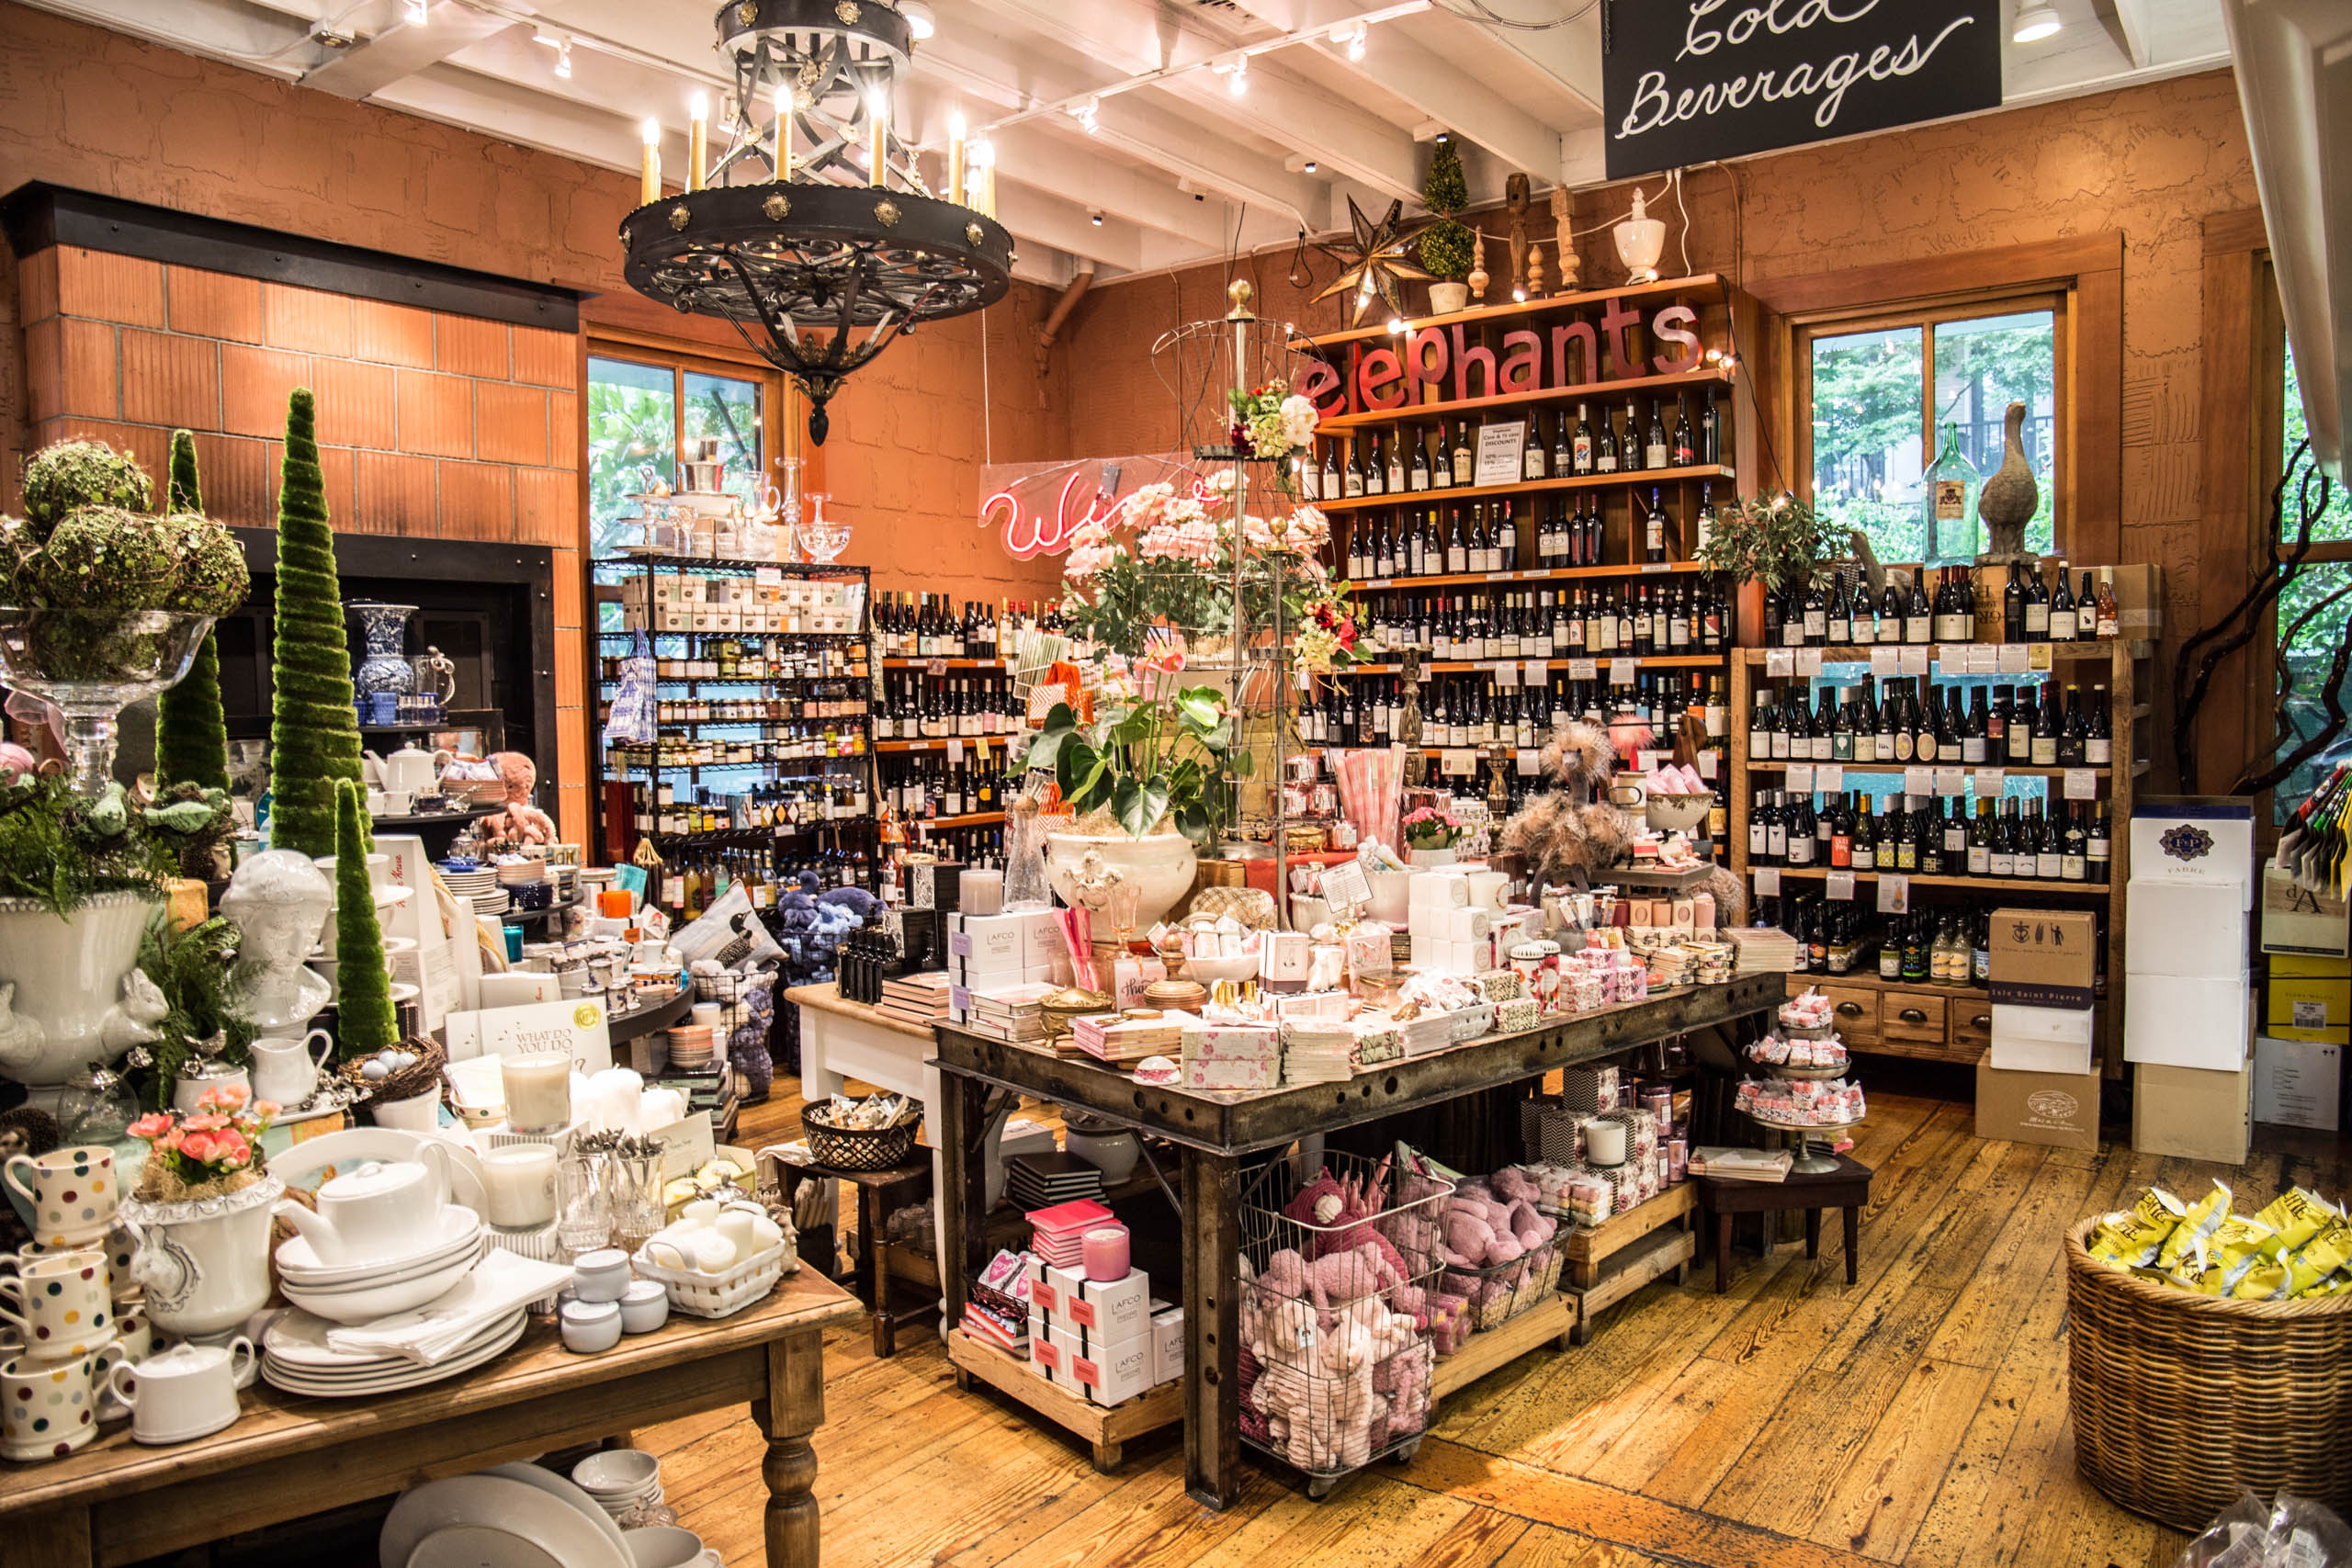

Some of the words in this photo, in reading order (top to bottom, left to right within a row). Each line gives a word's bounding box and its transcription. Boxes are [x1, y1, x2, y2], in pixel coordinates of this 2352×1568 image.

[1614, 17, 1974, 140] Beverages
[1296, 297, 1702, 420] elephants
[1485, 438, 1517, 446] DISCOUNTS
[981, 471, 1224, 553] Wie
[987, 931, 1015, 945] LAFCO
[1034, 926, 1060, 939] LAFCO
[2049, 992, 2081, 1002] Pierre
[516, 1031, 551, 1043] WHAT
[553, 1028, 571, 1040] DO
[517, 1041, 548, 1054] YOU
[551, 1038, 573, 1051] DO
[1111, 1294, 1141, 1315] LAFCO
[1164, 1336, 1184, 1353] LAFC
[1115, 1351, 1144, 1374] LAFCO
